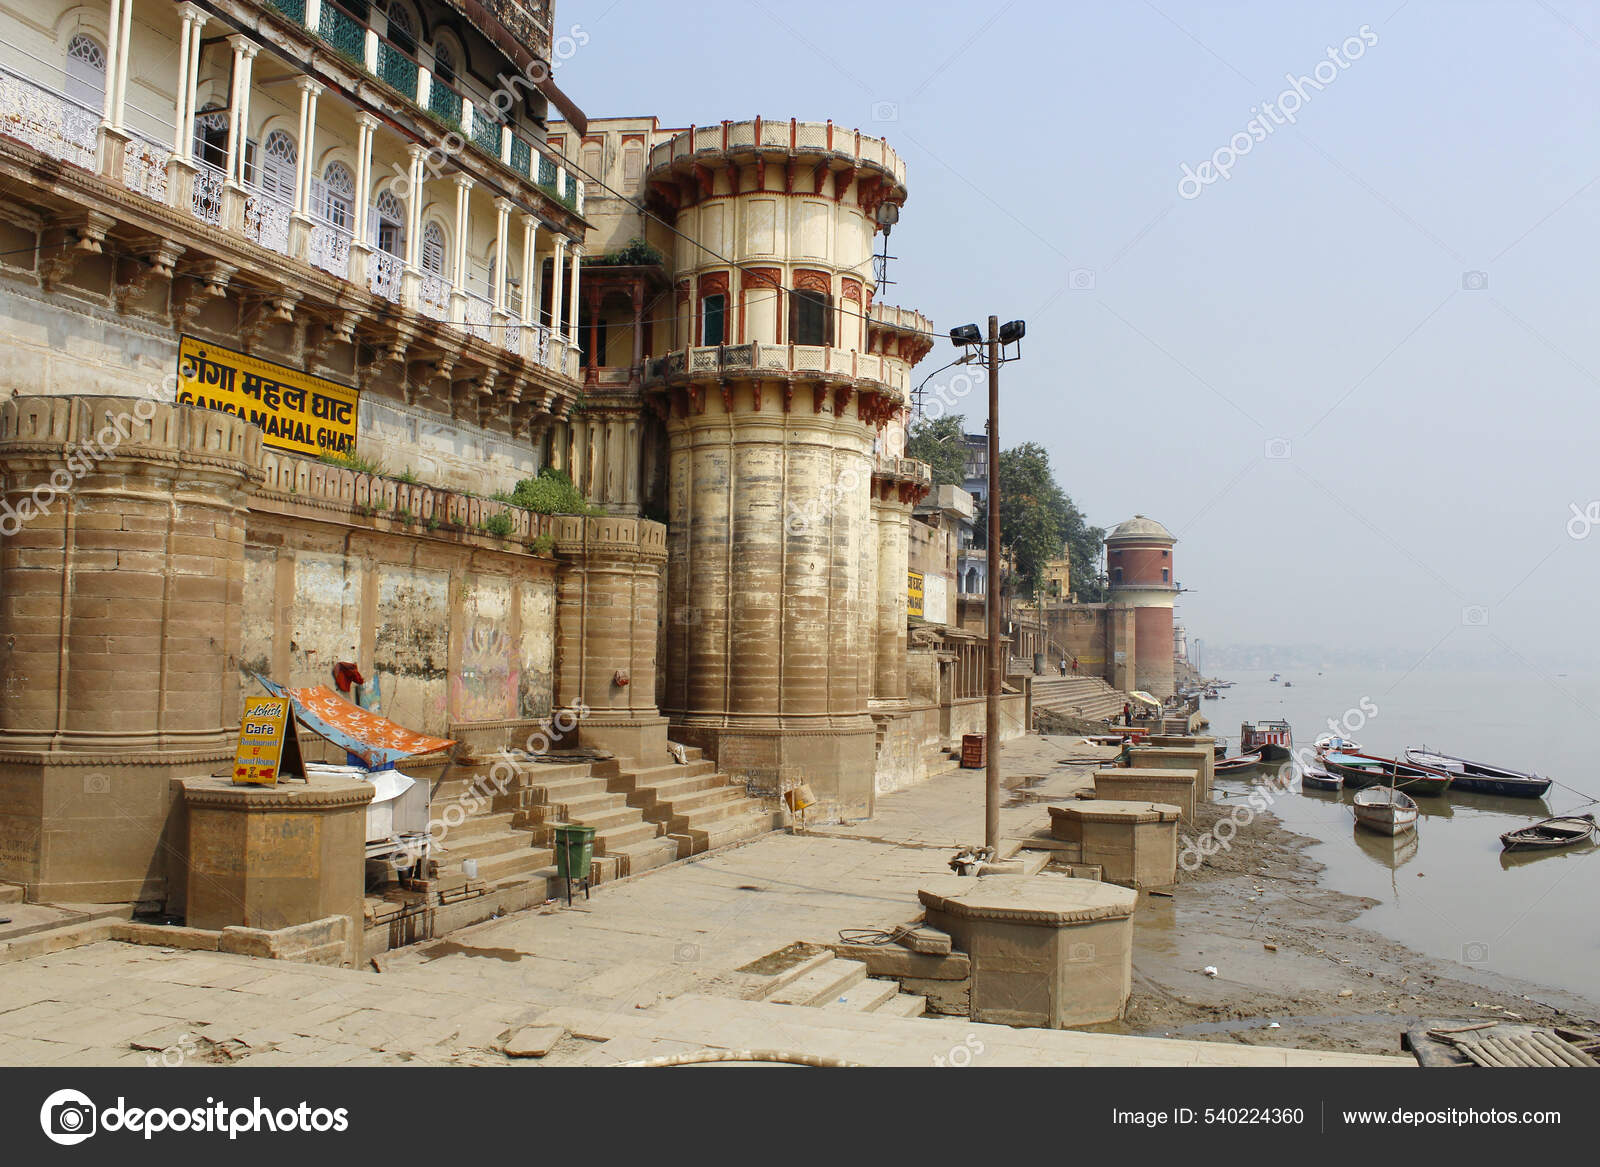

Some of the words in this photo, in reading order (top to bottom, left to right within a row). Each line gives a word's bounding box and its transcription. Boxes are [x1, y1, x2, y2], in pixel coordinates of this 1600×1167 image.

[182, 351, 237, 392] गंगा
[241, 371, 308, 413] महल
[312, 392, 353, 425] घाट
[317, 427, 354, 454] GHAT
